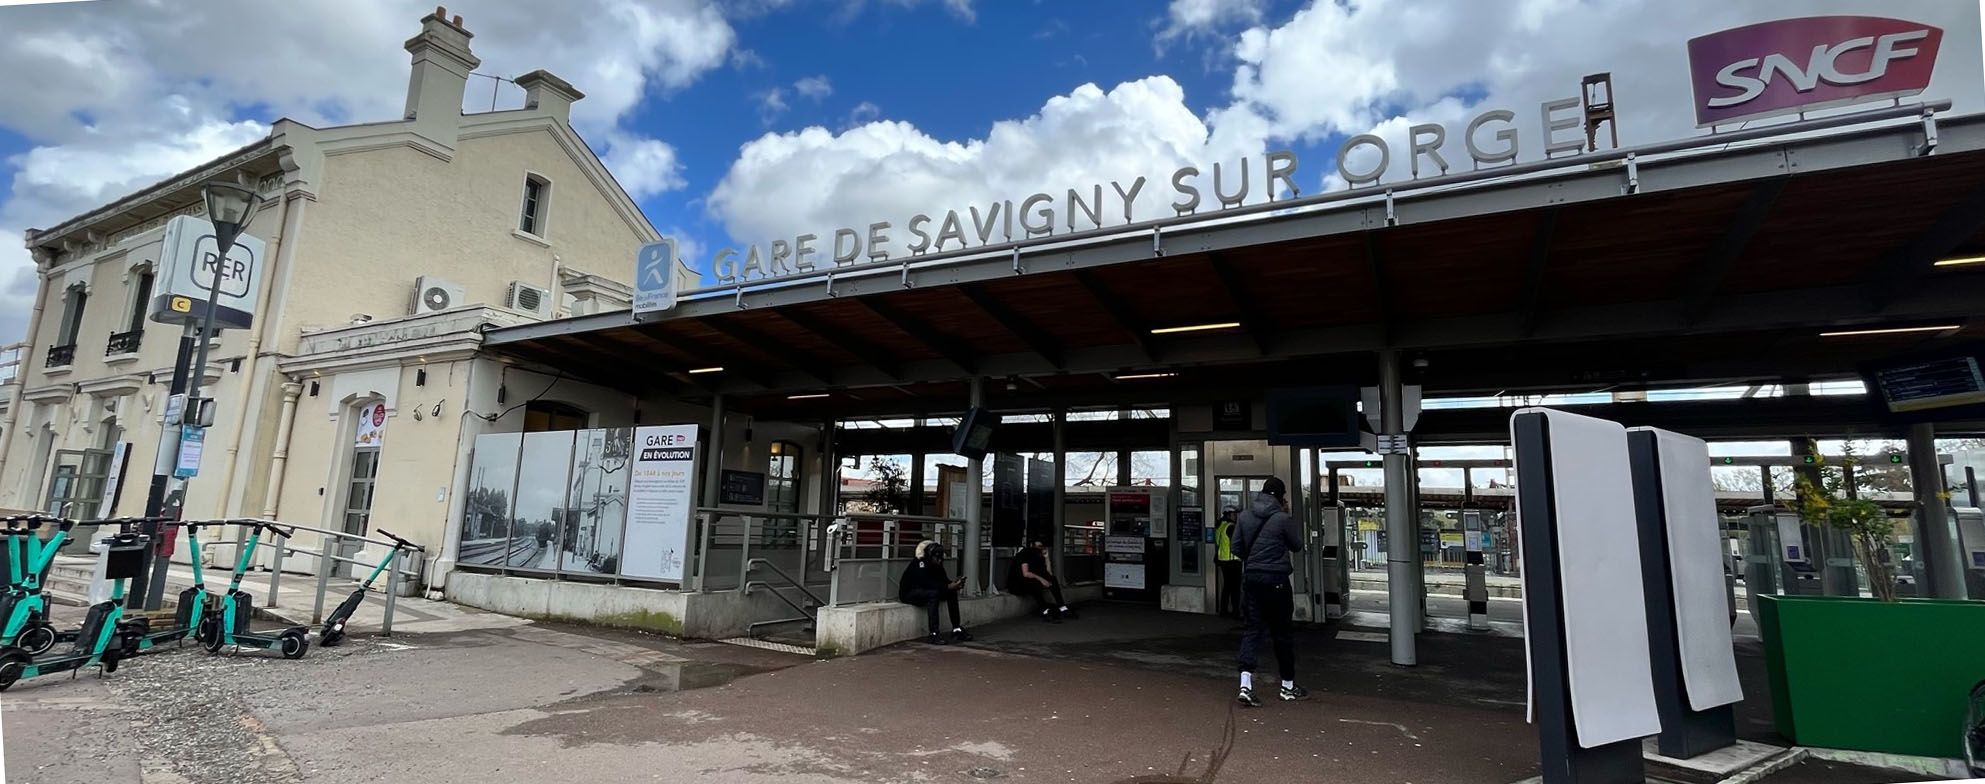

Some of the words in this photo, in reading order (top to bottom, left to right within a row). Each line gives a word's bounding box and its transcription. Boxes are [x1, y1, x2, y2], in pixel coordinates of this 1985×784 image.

[1707, 30, 1929, 107] SNCF
[713, 234, 817, 281] GARE
[833, 221, 891, 263] DE
[908, 176, 1146, 252] SAVIGNY
[1171, 151, 1300, 212] SUR
[1338, 97, 1586, 183] ORGE
[202, 252, 245, 281] RER
[643, 451, 653, 459] EN
[653, 450, 690, 459] ÉVOLUTION
[646, 435, 674, 446] GARE
